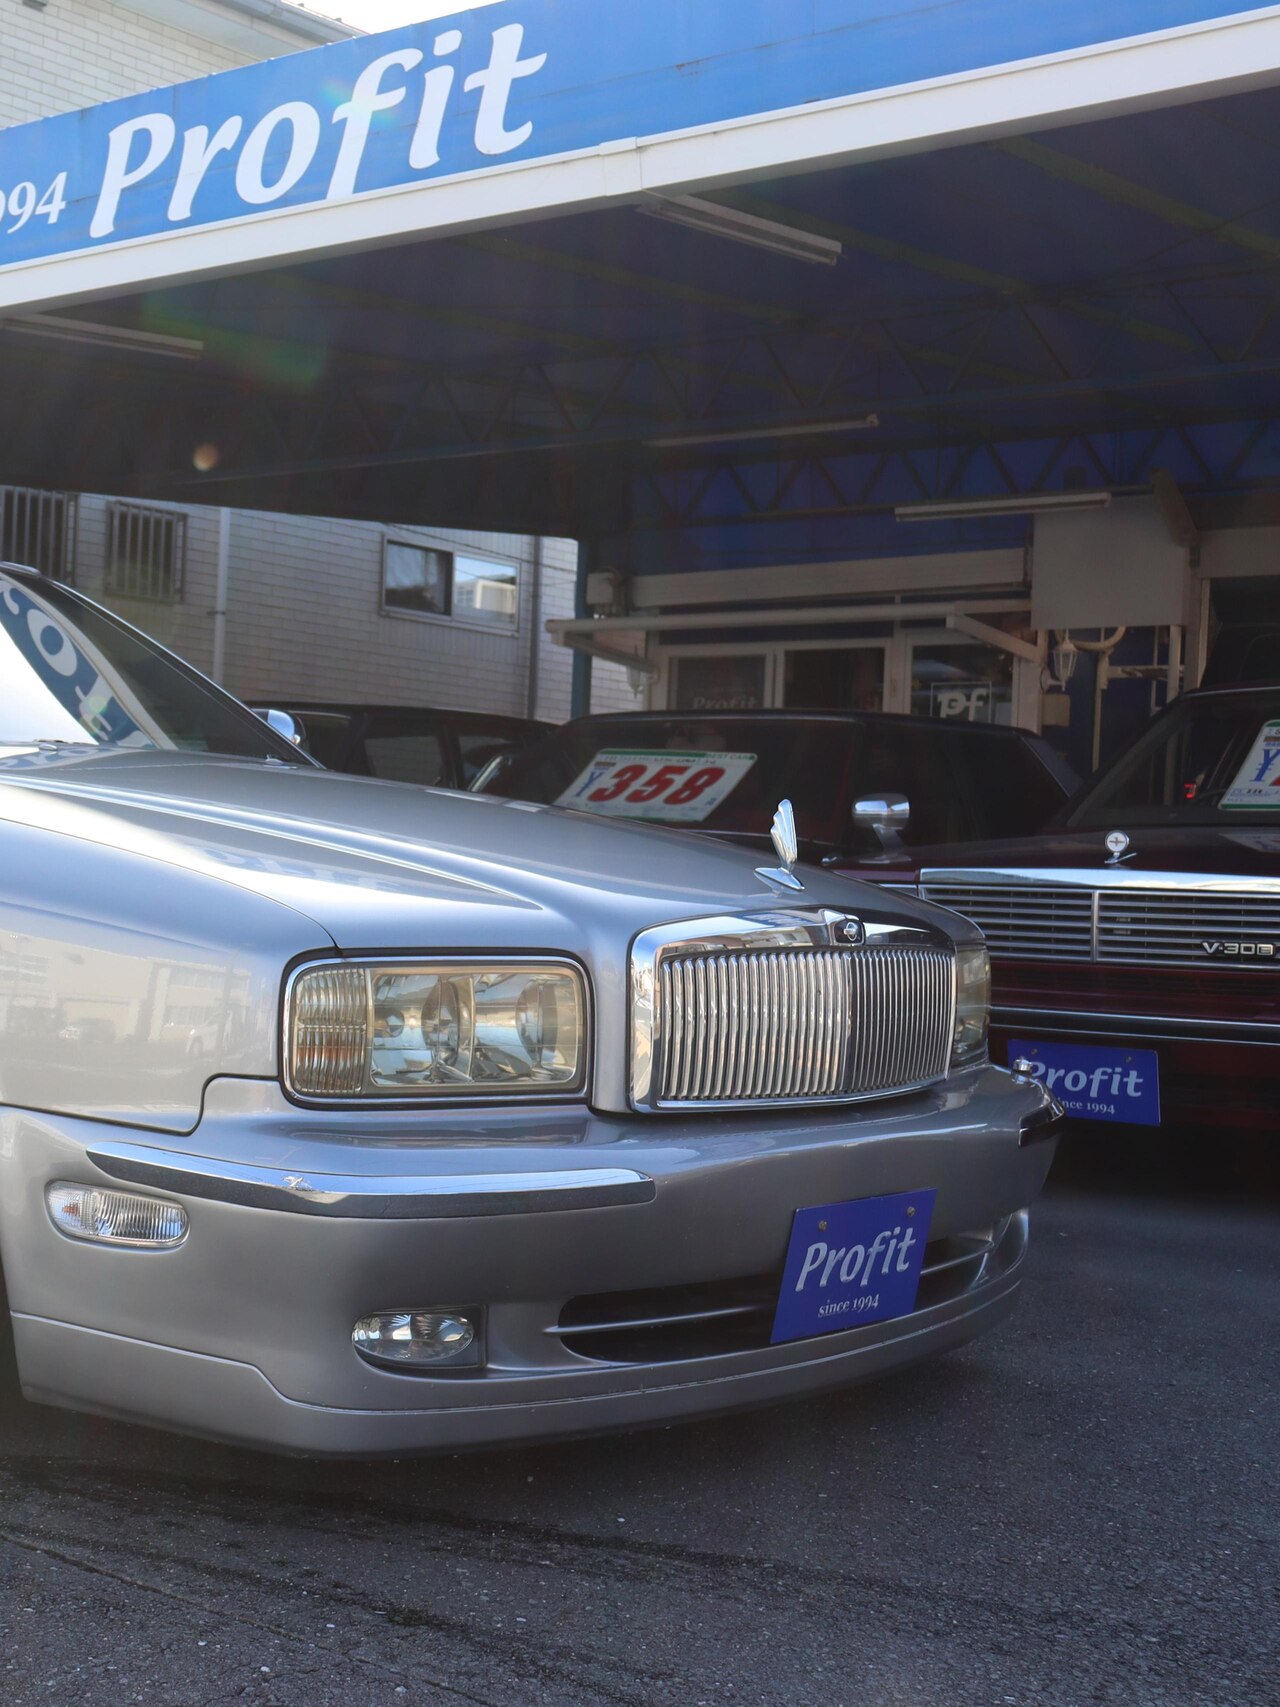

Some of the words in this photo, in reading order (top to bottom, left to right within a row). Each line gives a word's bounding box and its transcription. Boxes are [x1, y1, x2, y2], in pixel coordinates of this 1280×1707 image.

[89, 23, 548, 239] Profit
[587, 764, 725, 805] 358
[1086, 1101, 1116, 1115] 1994
[795, 1226, 917, 1292] Profit
[818, 1299, 850, 1318] since
[852, 1293, 880, 1313] 1994
